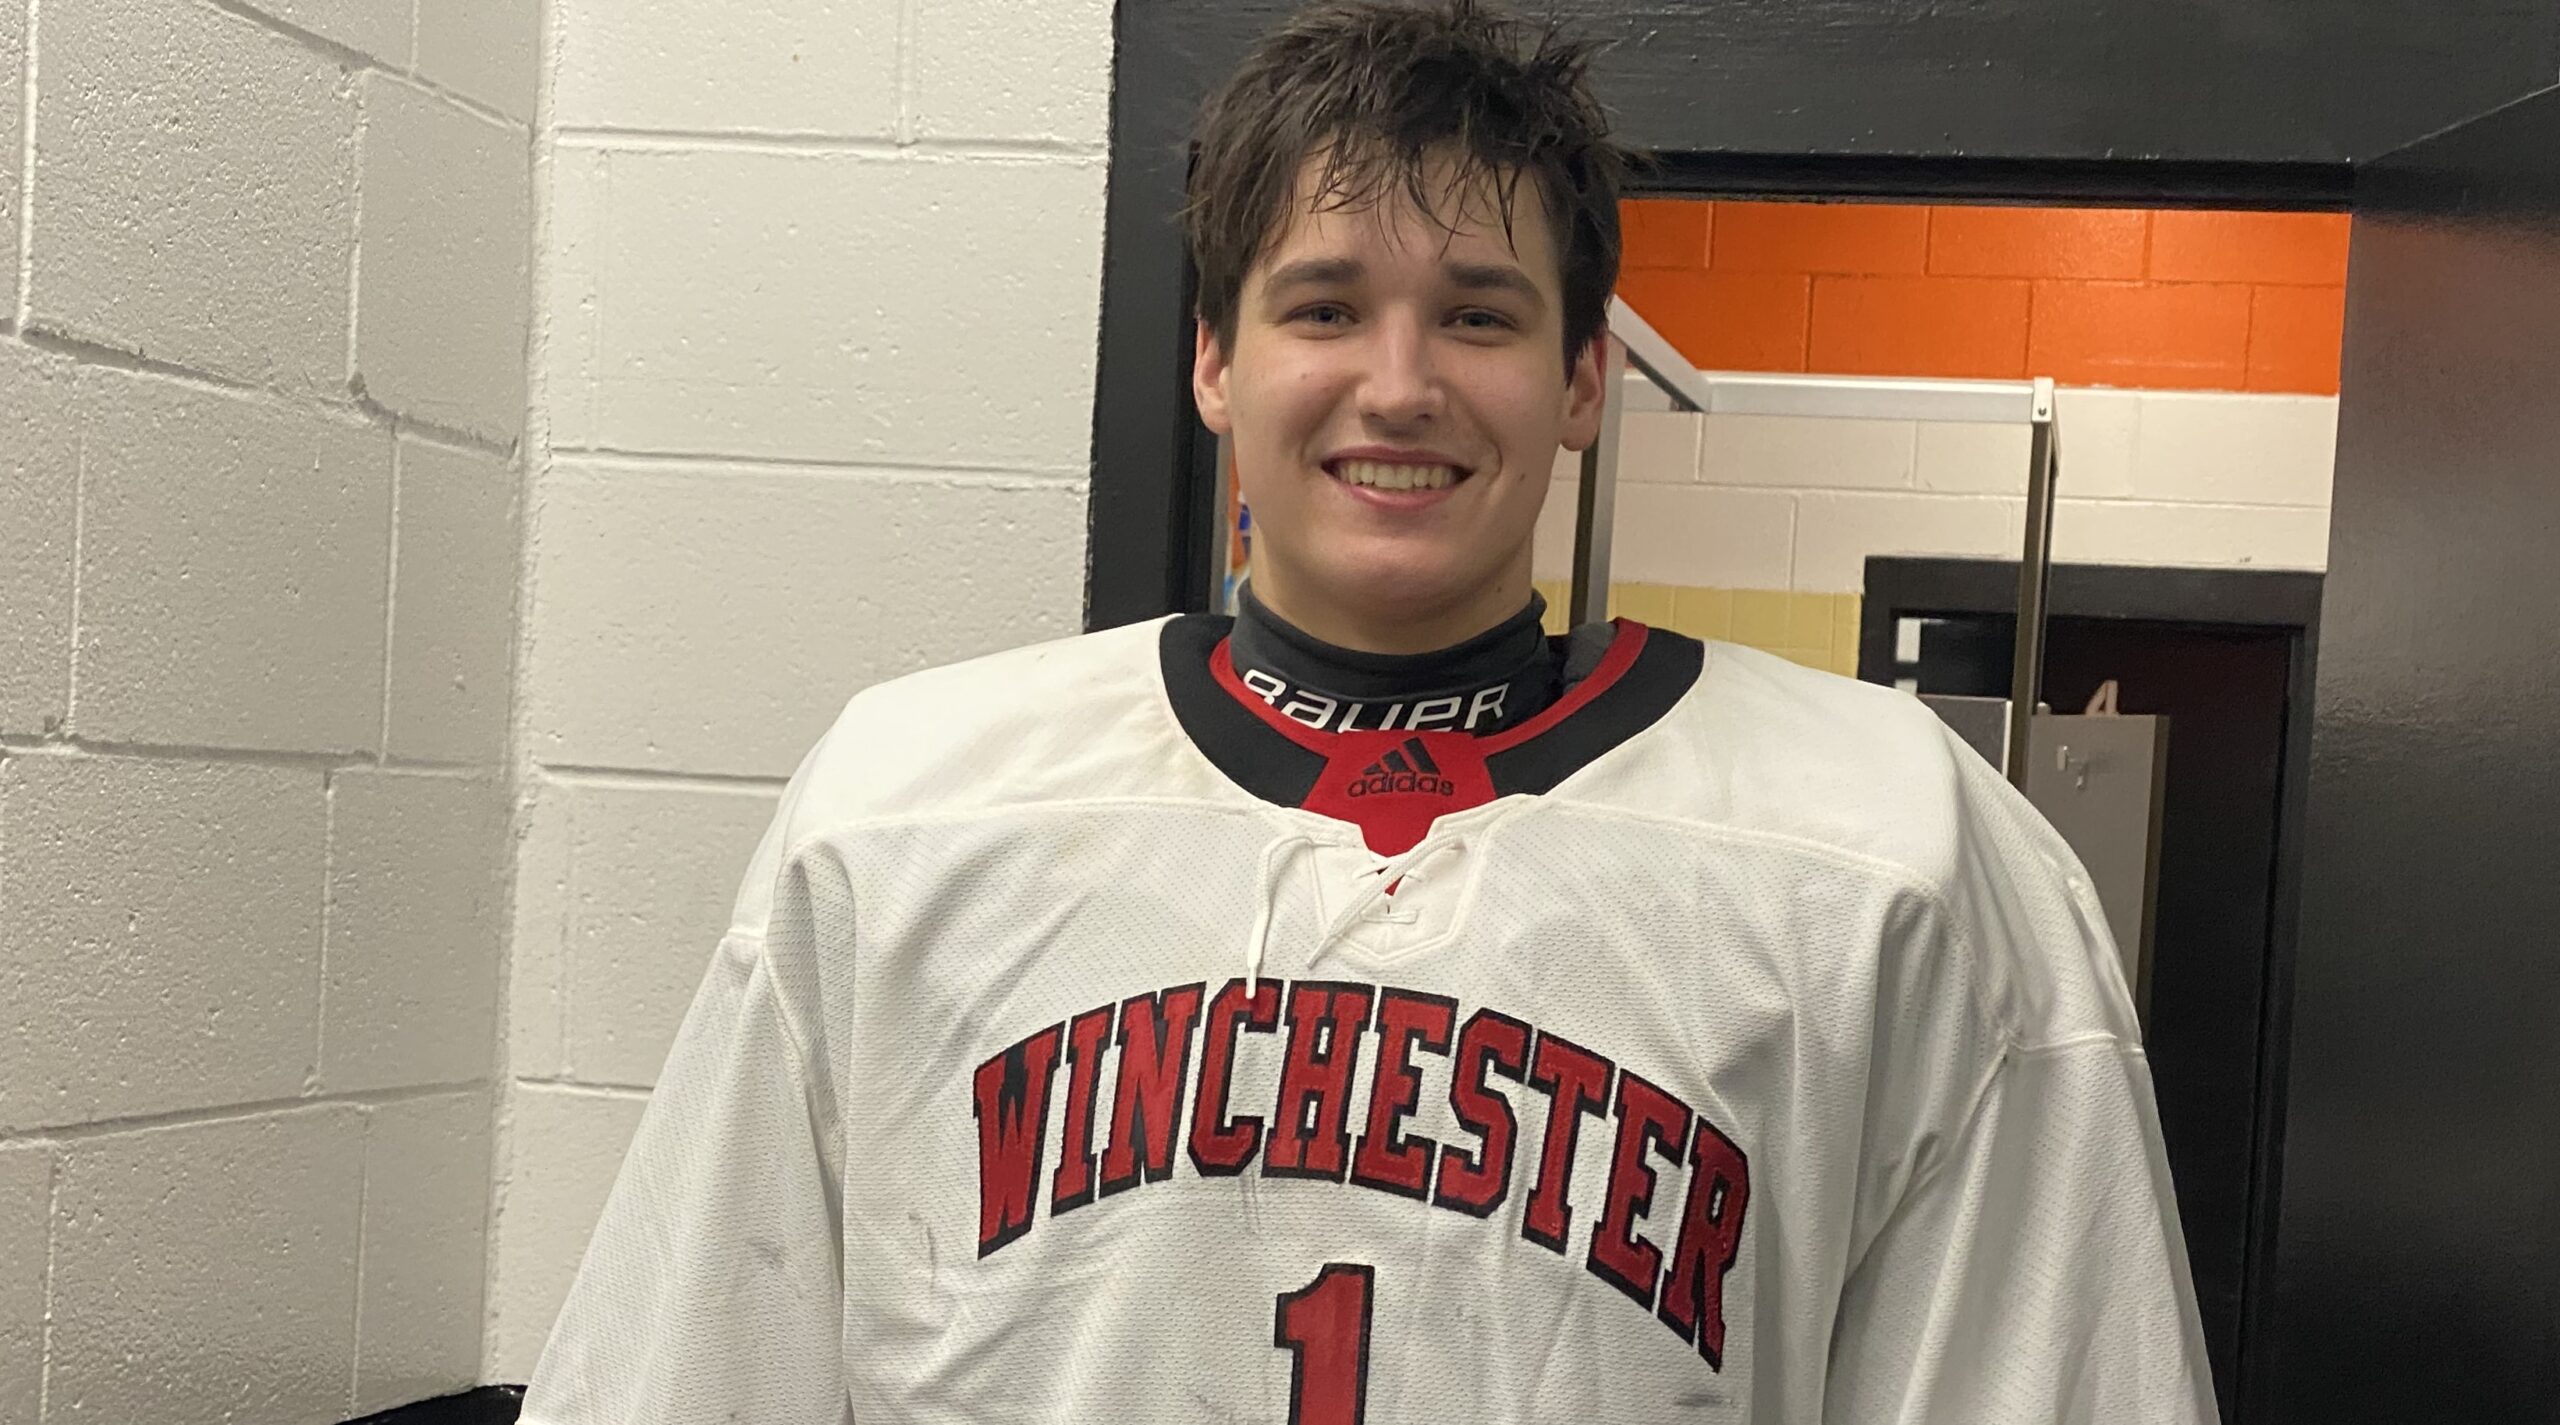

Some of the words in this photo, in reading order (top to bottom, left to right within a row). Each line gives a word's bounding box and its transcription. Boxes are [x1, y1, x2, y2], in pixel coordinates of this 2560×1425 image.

[1347, 771, 1455, 797] adidas
[973, 978, 1751, 1374] WINCHESTER
[1274, 1263, 1376, 1425] 1
